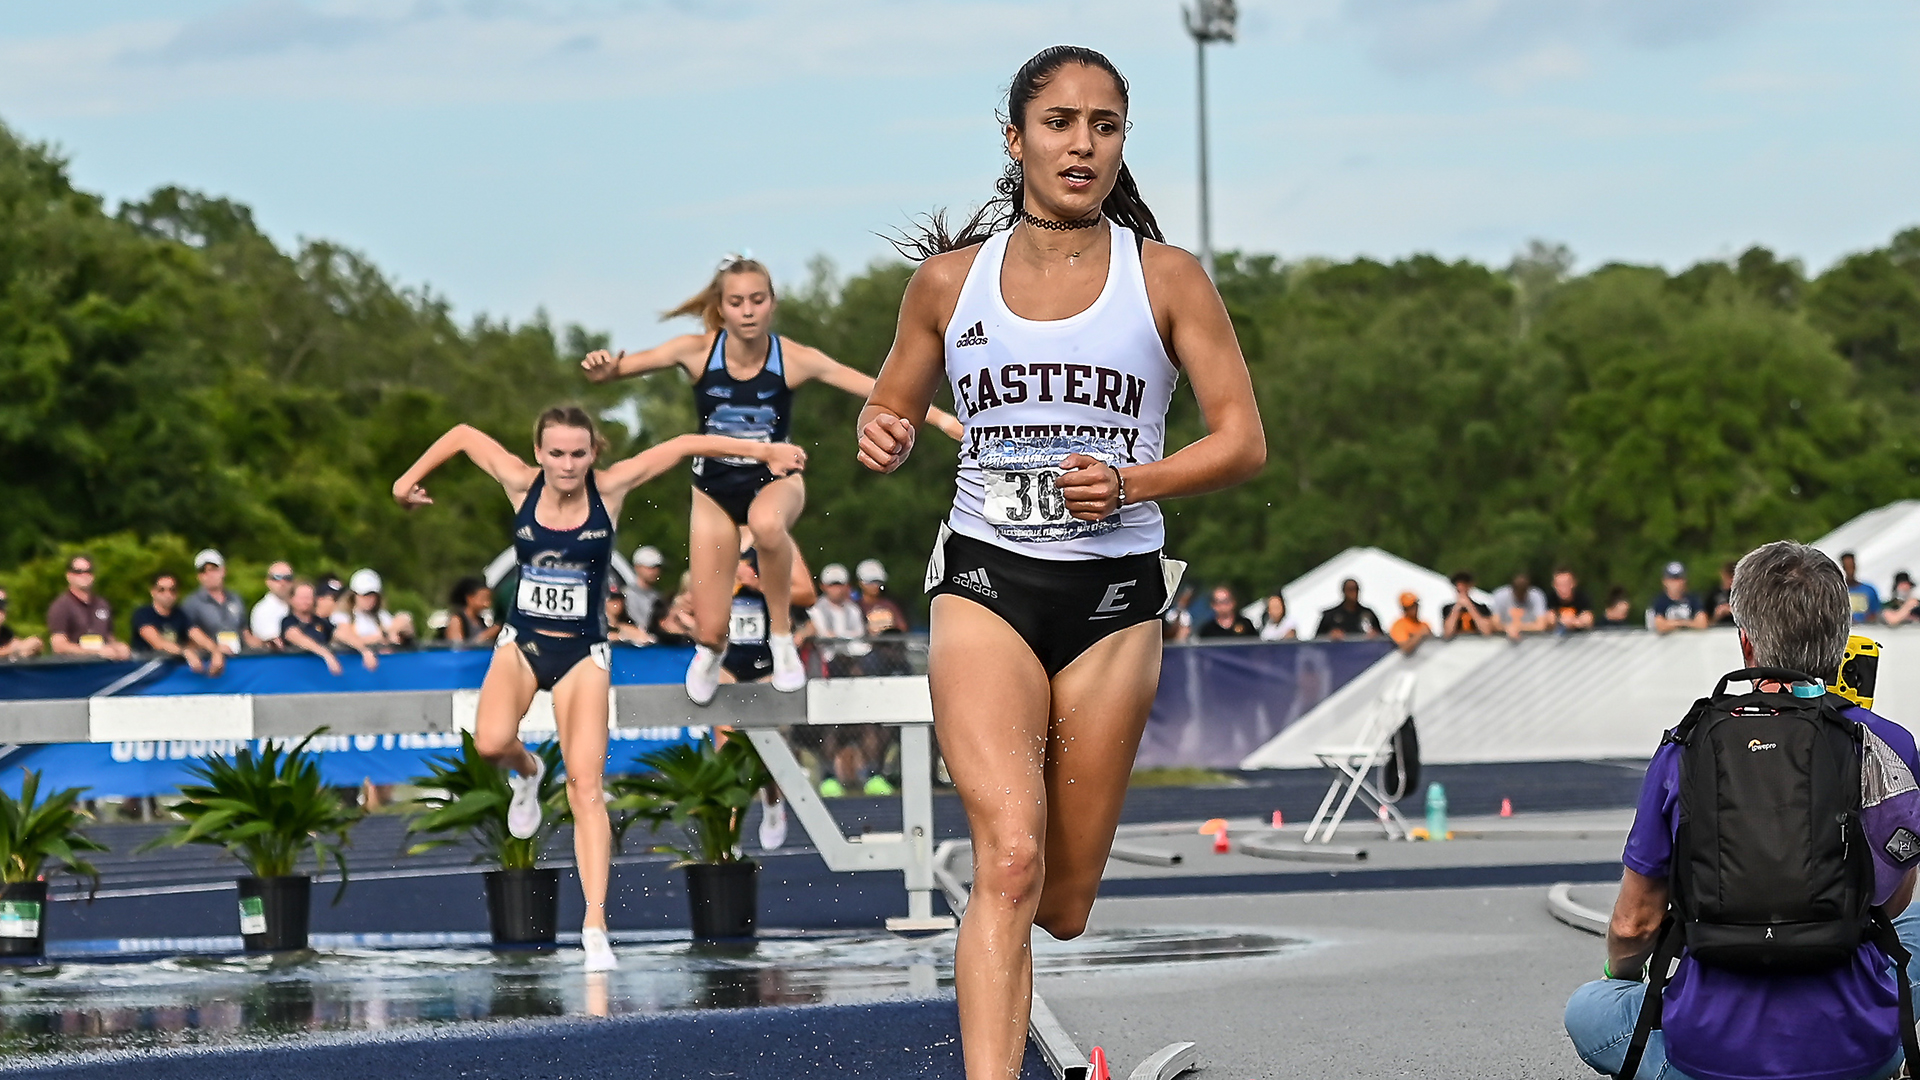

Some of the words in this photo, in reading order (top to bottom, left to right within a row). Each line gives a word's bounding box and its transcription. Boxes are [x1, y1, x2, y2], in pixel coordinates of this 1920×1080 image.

[956, 335, 988, 348] adidas
[957, 363, 1147, 419] EASTERN
[530, 586, 575, 613] 485
[952, 575, 998, 599] adidas
[1094, 579, 1138, 613] E
